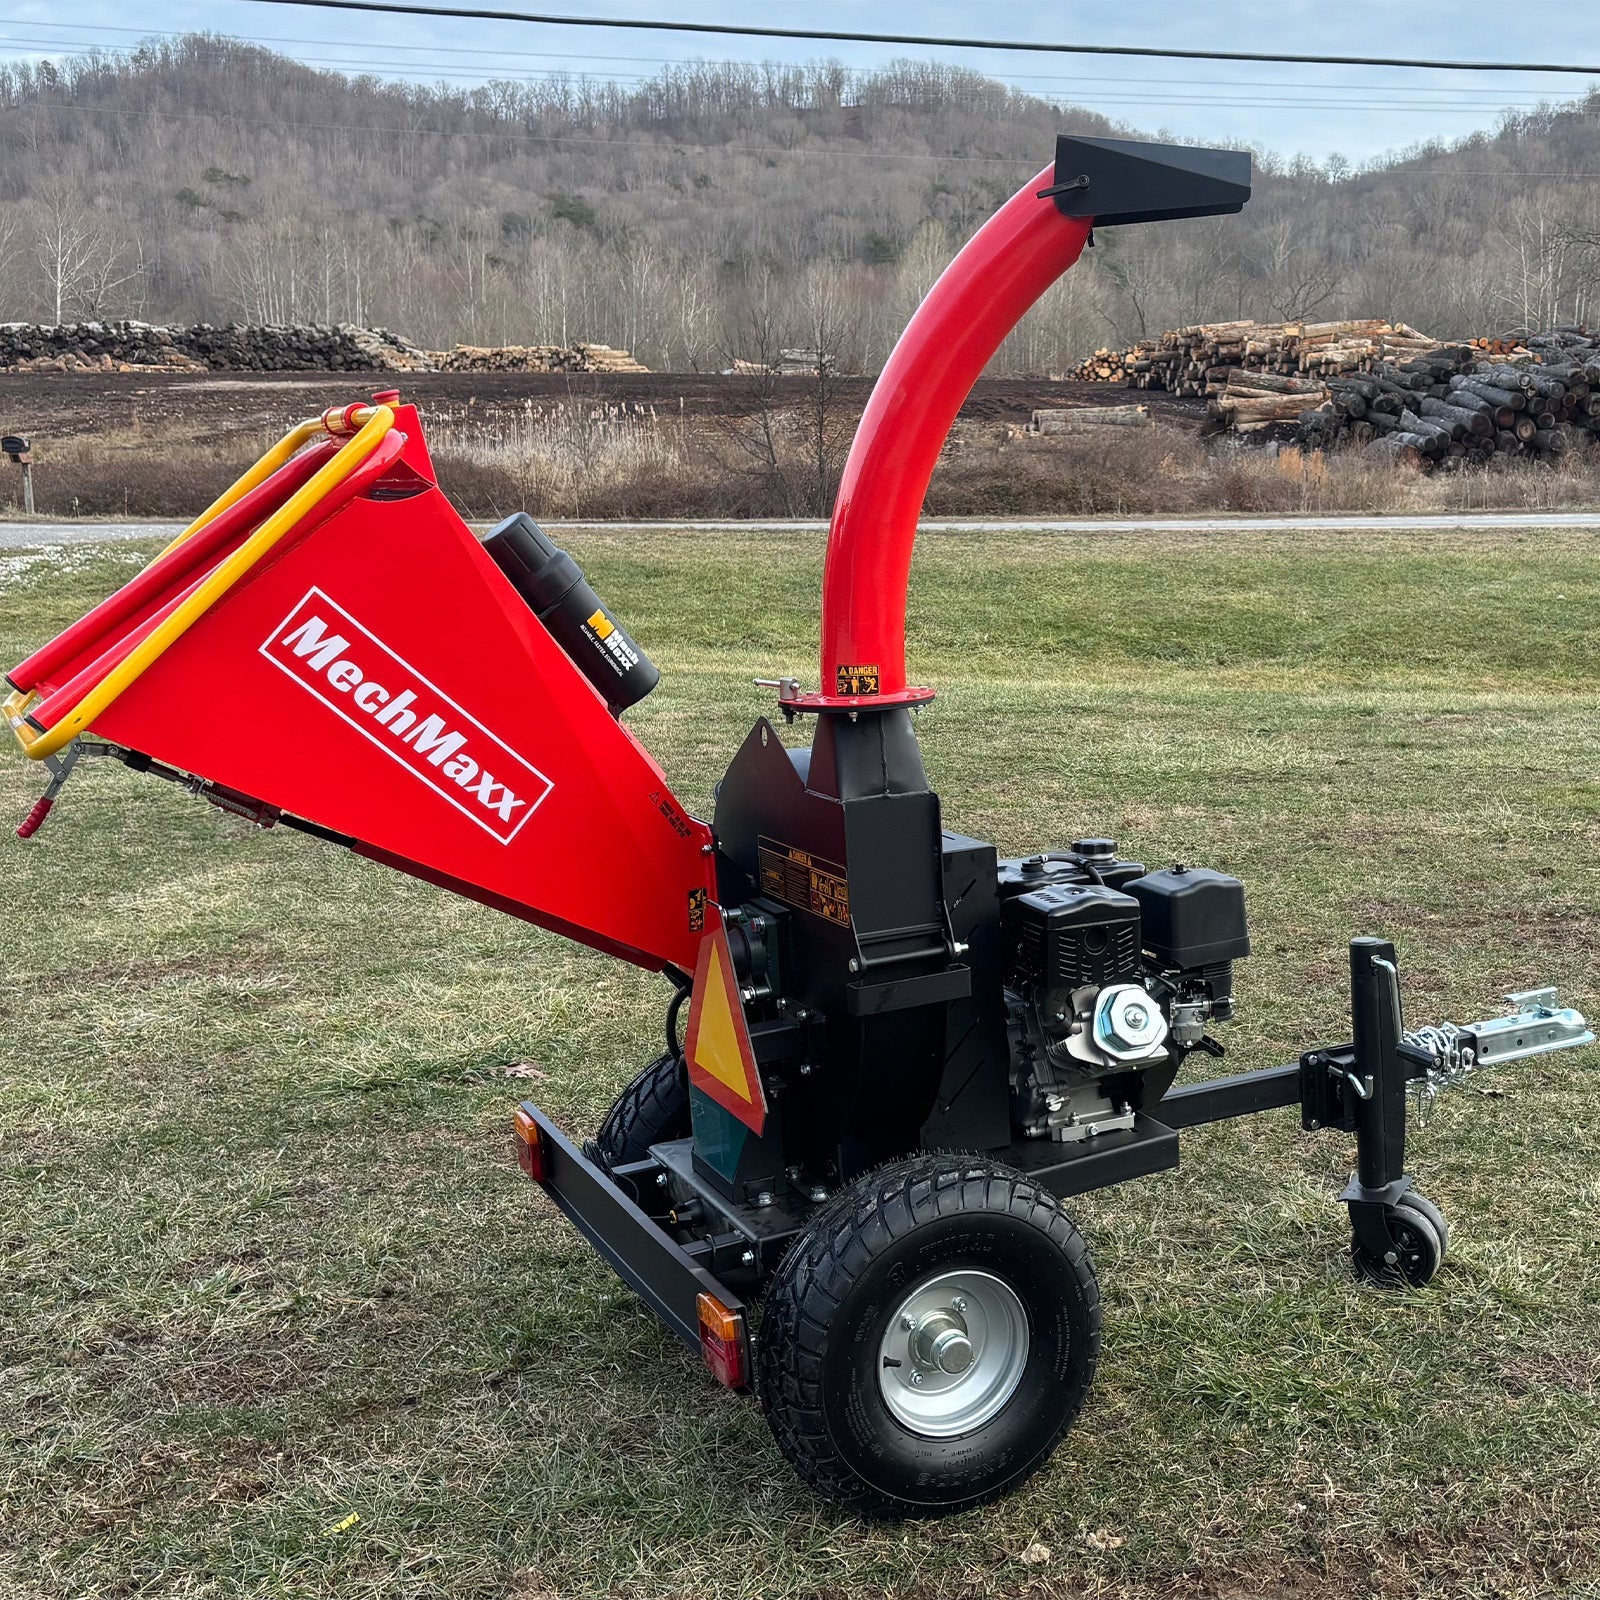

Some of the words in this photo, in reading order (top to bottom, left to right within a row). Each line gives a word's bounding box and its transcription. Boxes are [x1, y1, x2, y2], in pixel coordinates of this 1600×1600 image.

[604, 639, 633, 671] Maxx
[612, 629, 639, 665] Mech
[848, 666, 878, 675] DANGER
[281, 615, 526, 822] MechMaxx
